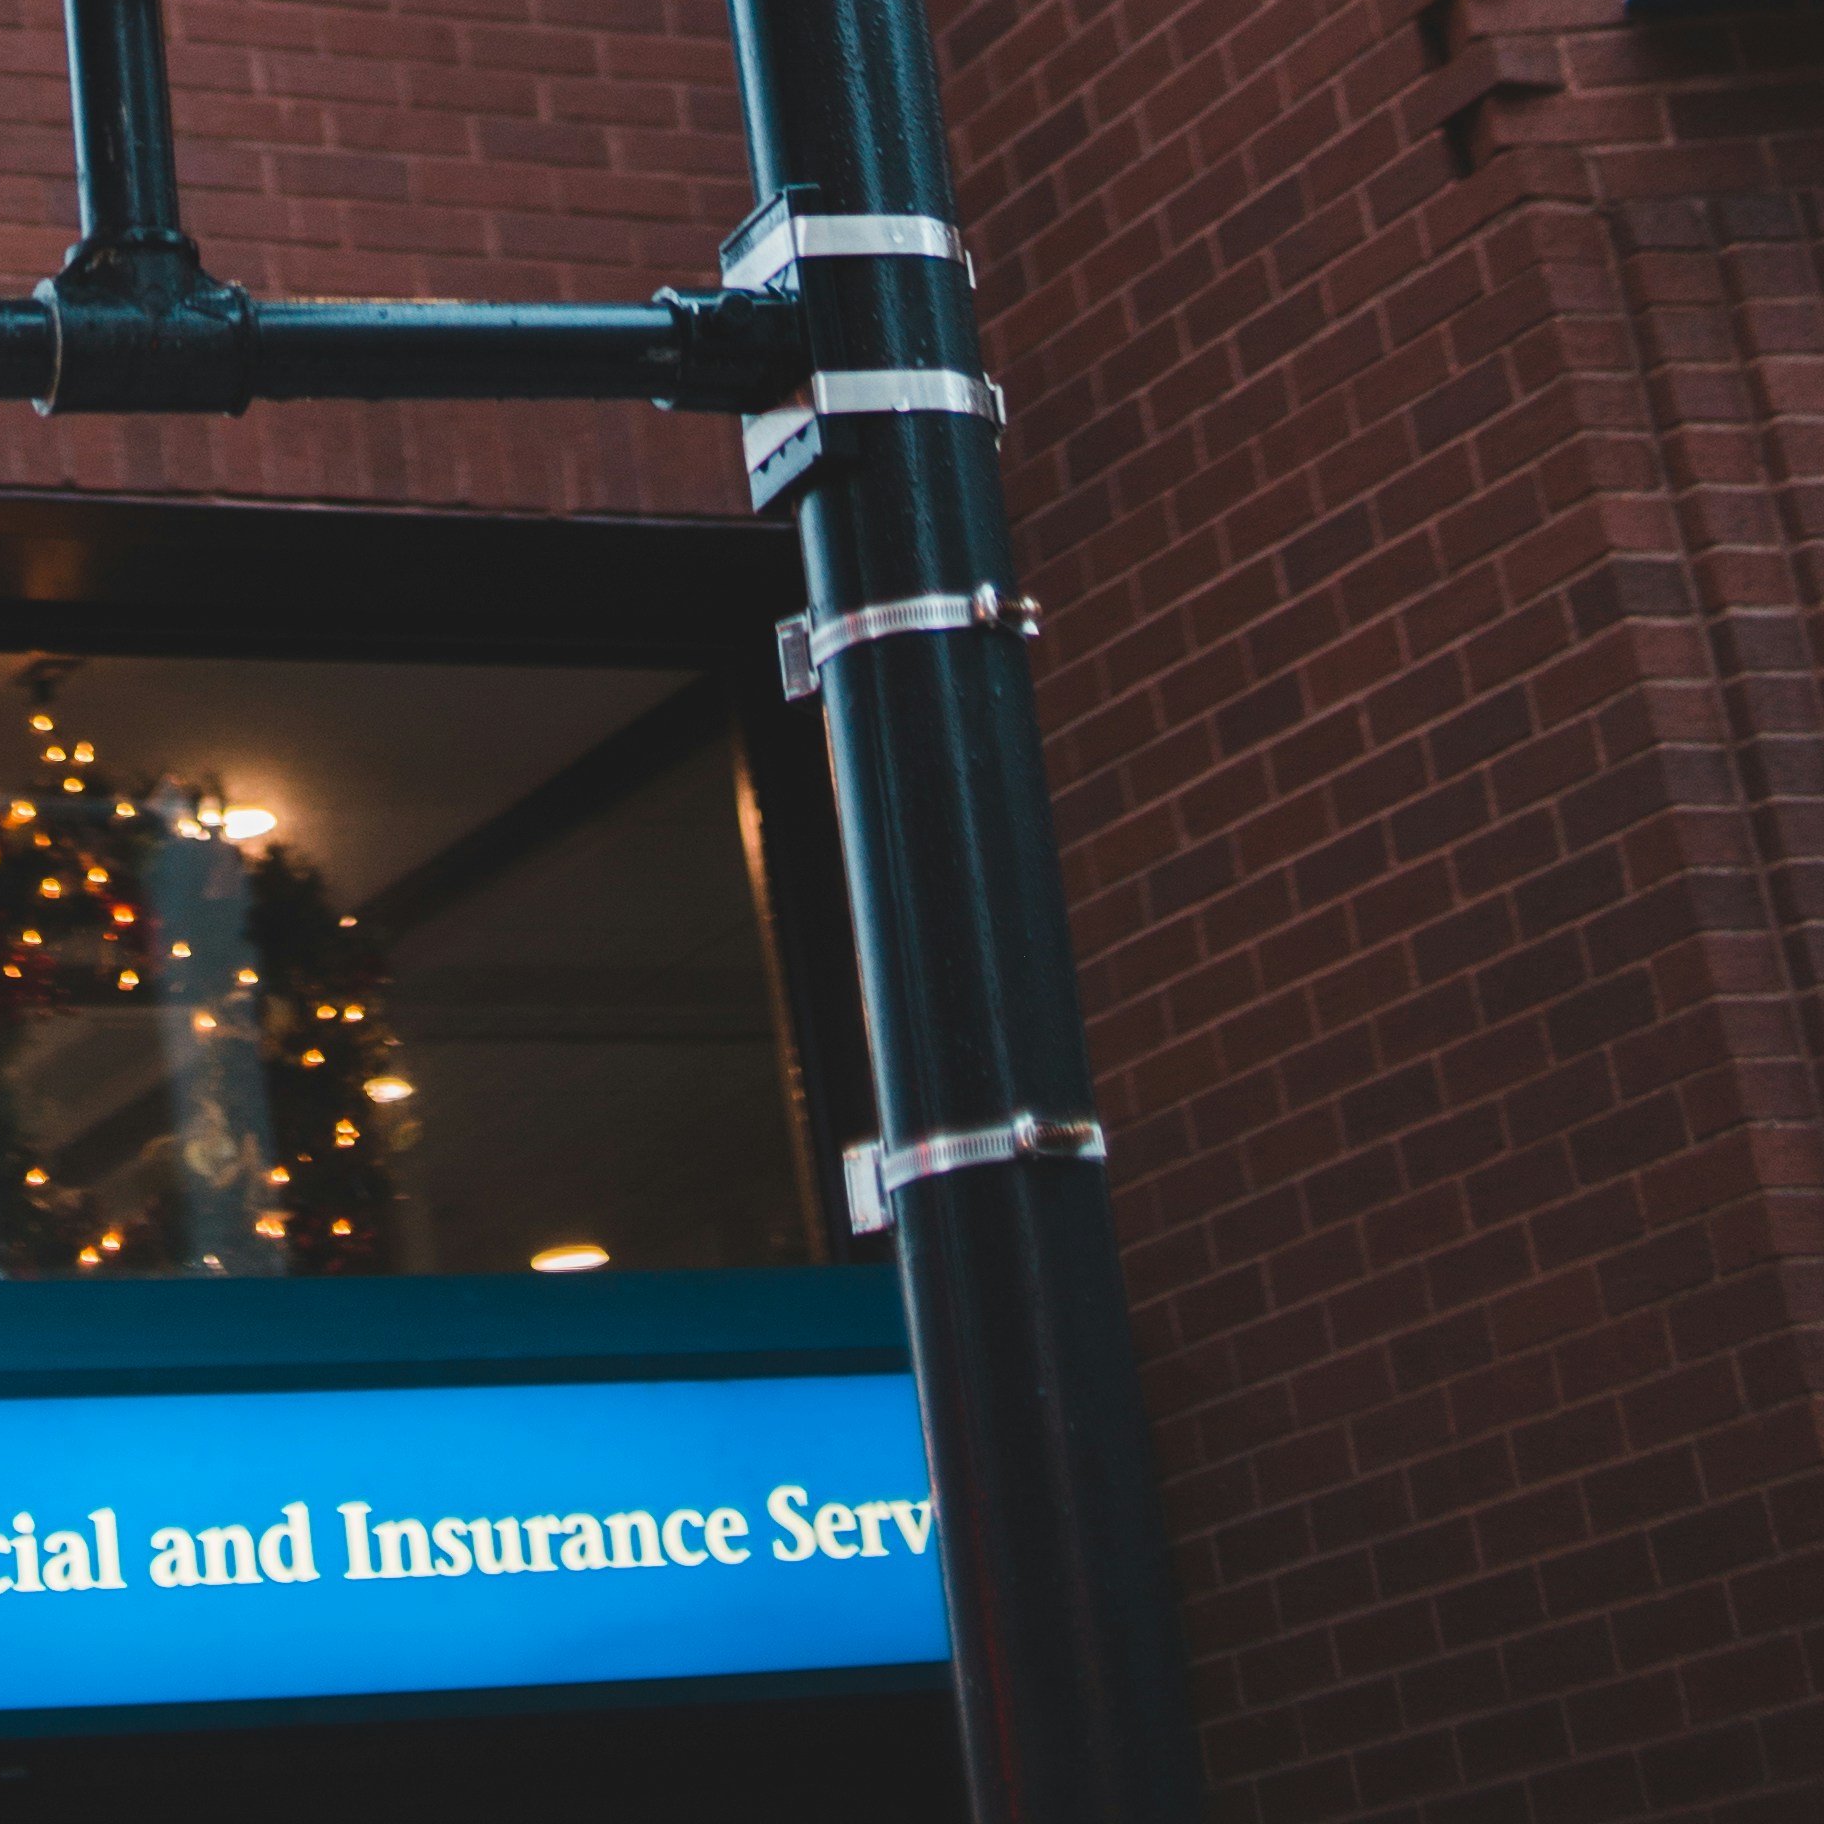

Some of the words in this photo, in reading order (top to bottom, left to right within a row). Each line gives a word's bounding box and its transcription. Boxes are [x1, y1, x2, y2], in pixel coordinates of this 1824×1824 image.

[148, 1501, 322, 1588] and
[336, 1500, 752, 1581] Insurance
[766, 1484, 933, 1563] Serv
